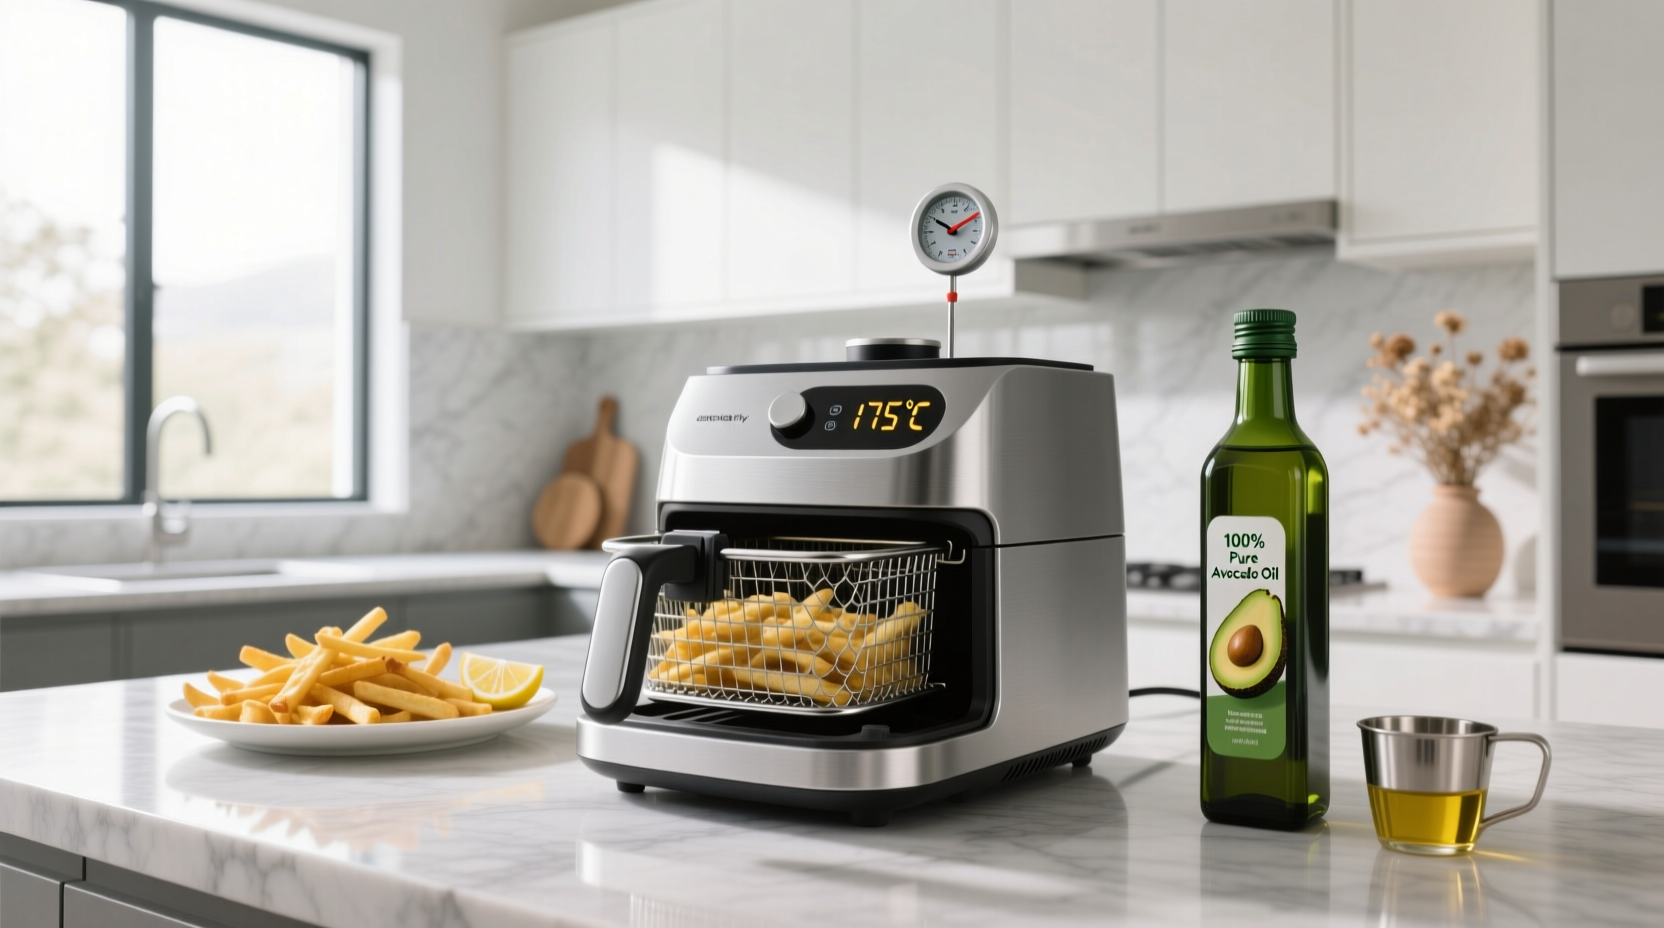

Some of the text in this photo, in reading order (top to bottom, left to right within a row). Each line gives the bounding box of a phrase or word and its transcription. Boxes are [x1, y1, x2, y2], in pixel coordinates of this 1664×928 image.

[853, 399, 931, 431] 175°C
[1224, 533, 1265, 549] 100%
[1229, 551, 1259, 564] Pure
[1261, 566, 1279, 581] Oil
